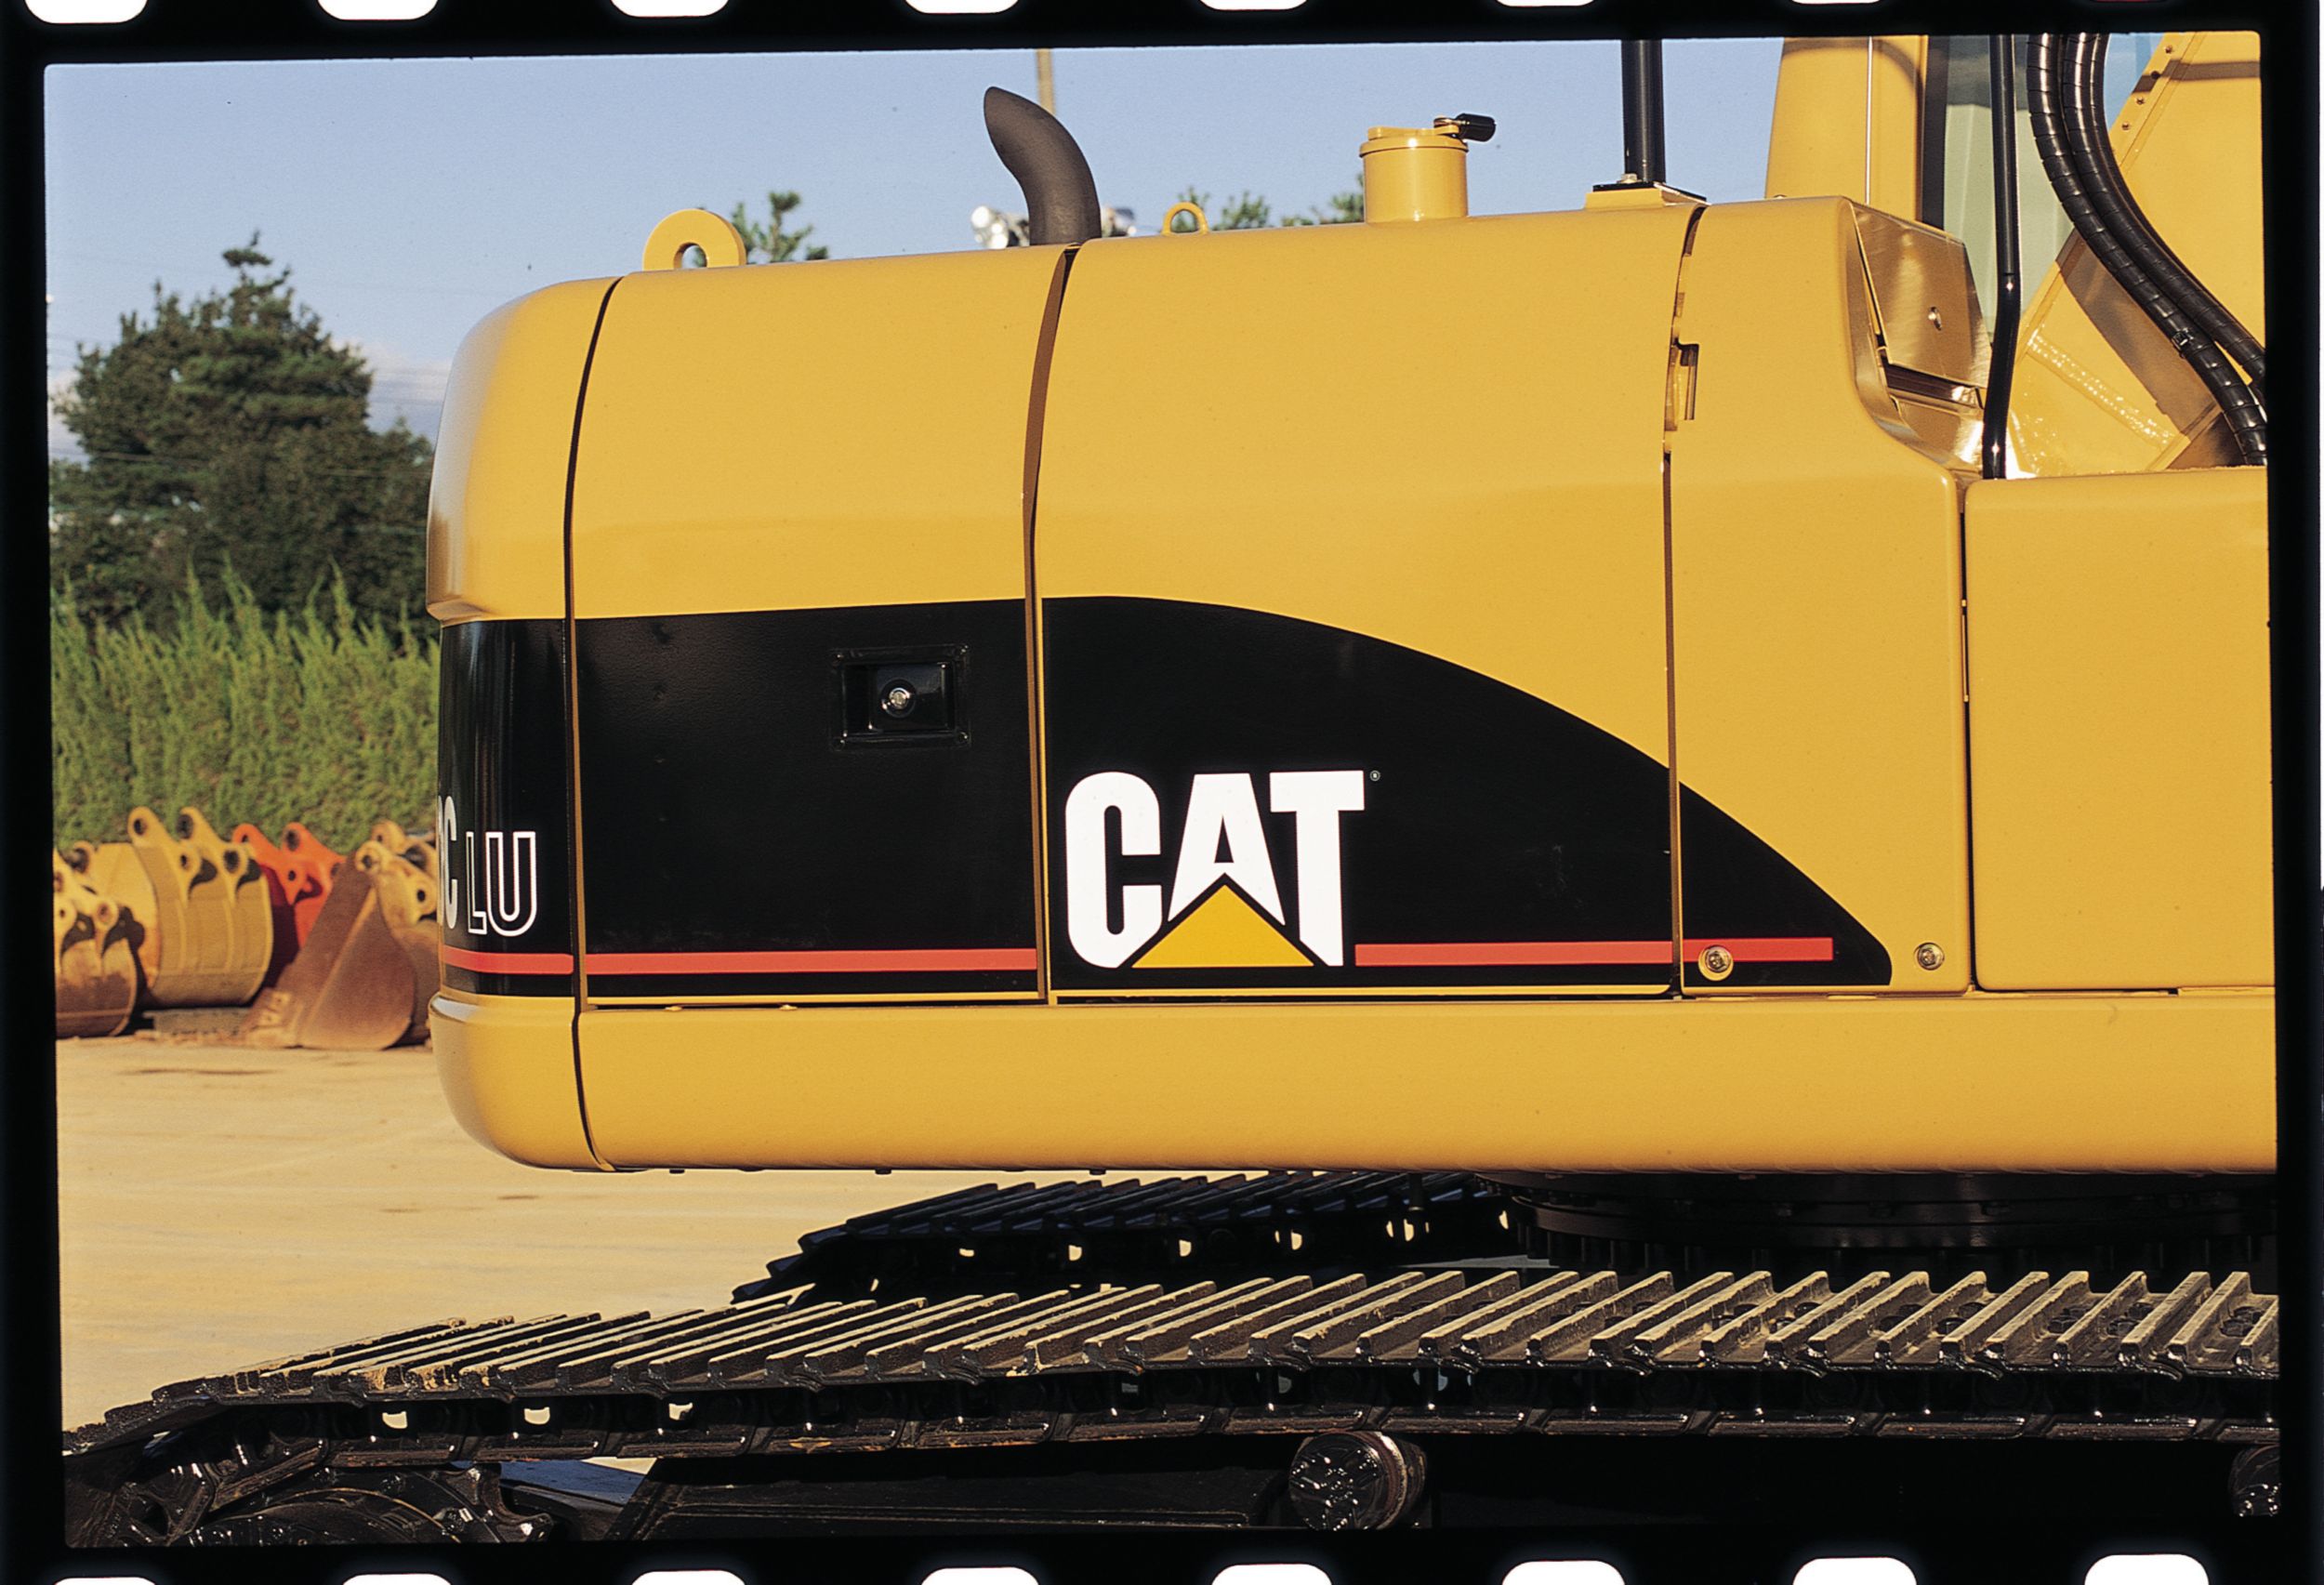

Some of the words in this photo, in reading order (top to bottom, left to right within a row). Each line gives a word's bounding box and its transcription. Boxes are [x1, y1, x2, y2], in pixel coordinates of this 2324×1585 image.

[438, 796, 457, 929] C
[466, 831, 537, 937] LU
[1064, 771, 1365, 969] CAT
